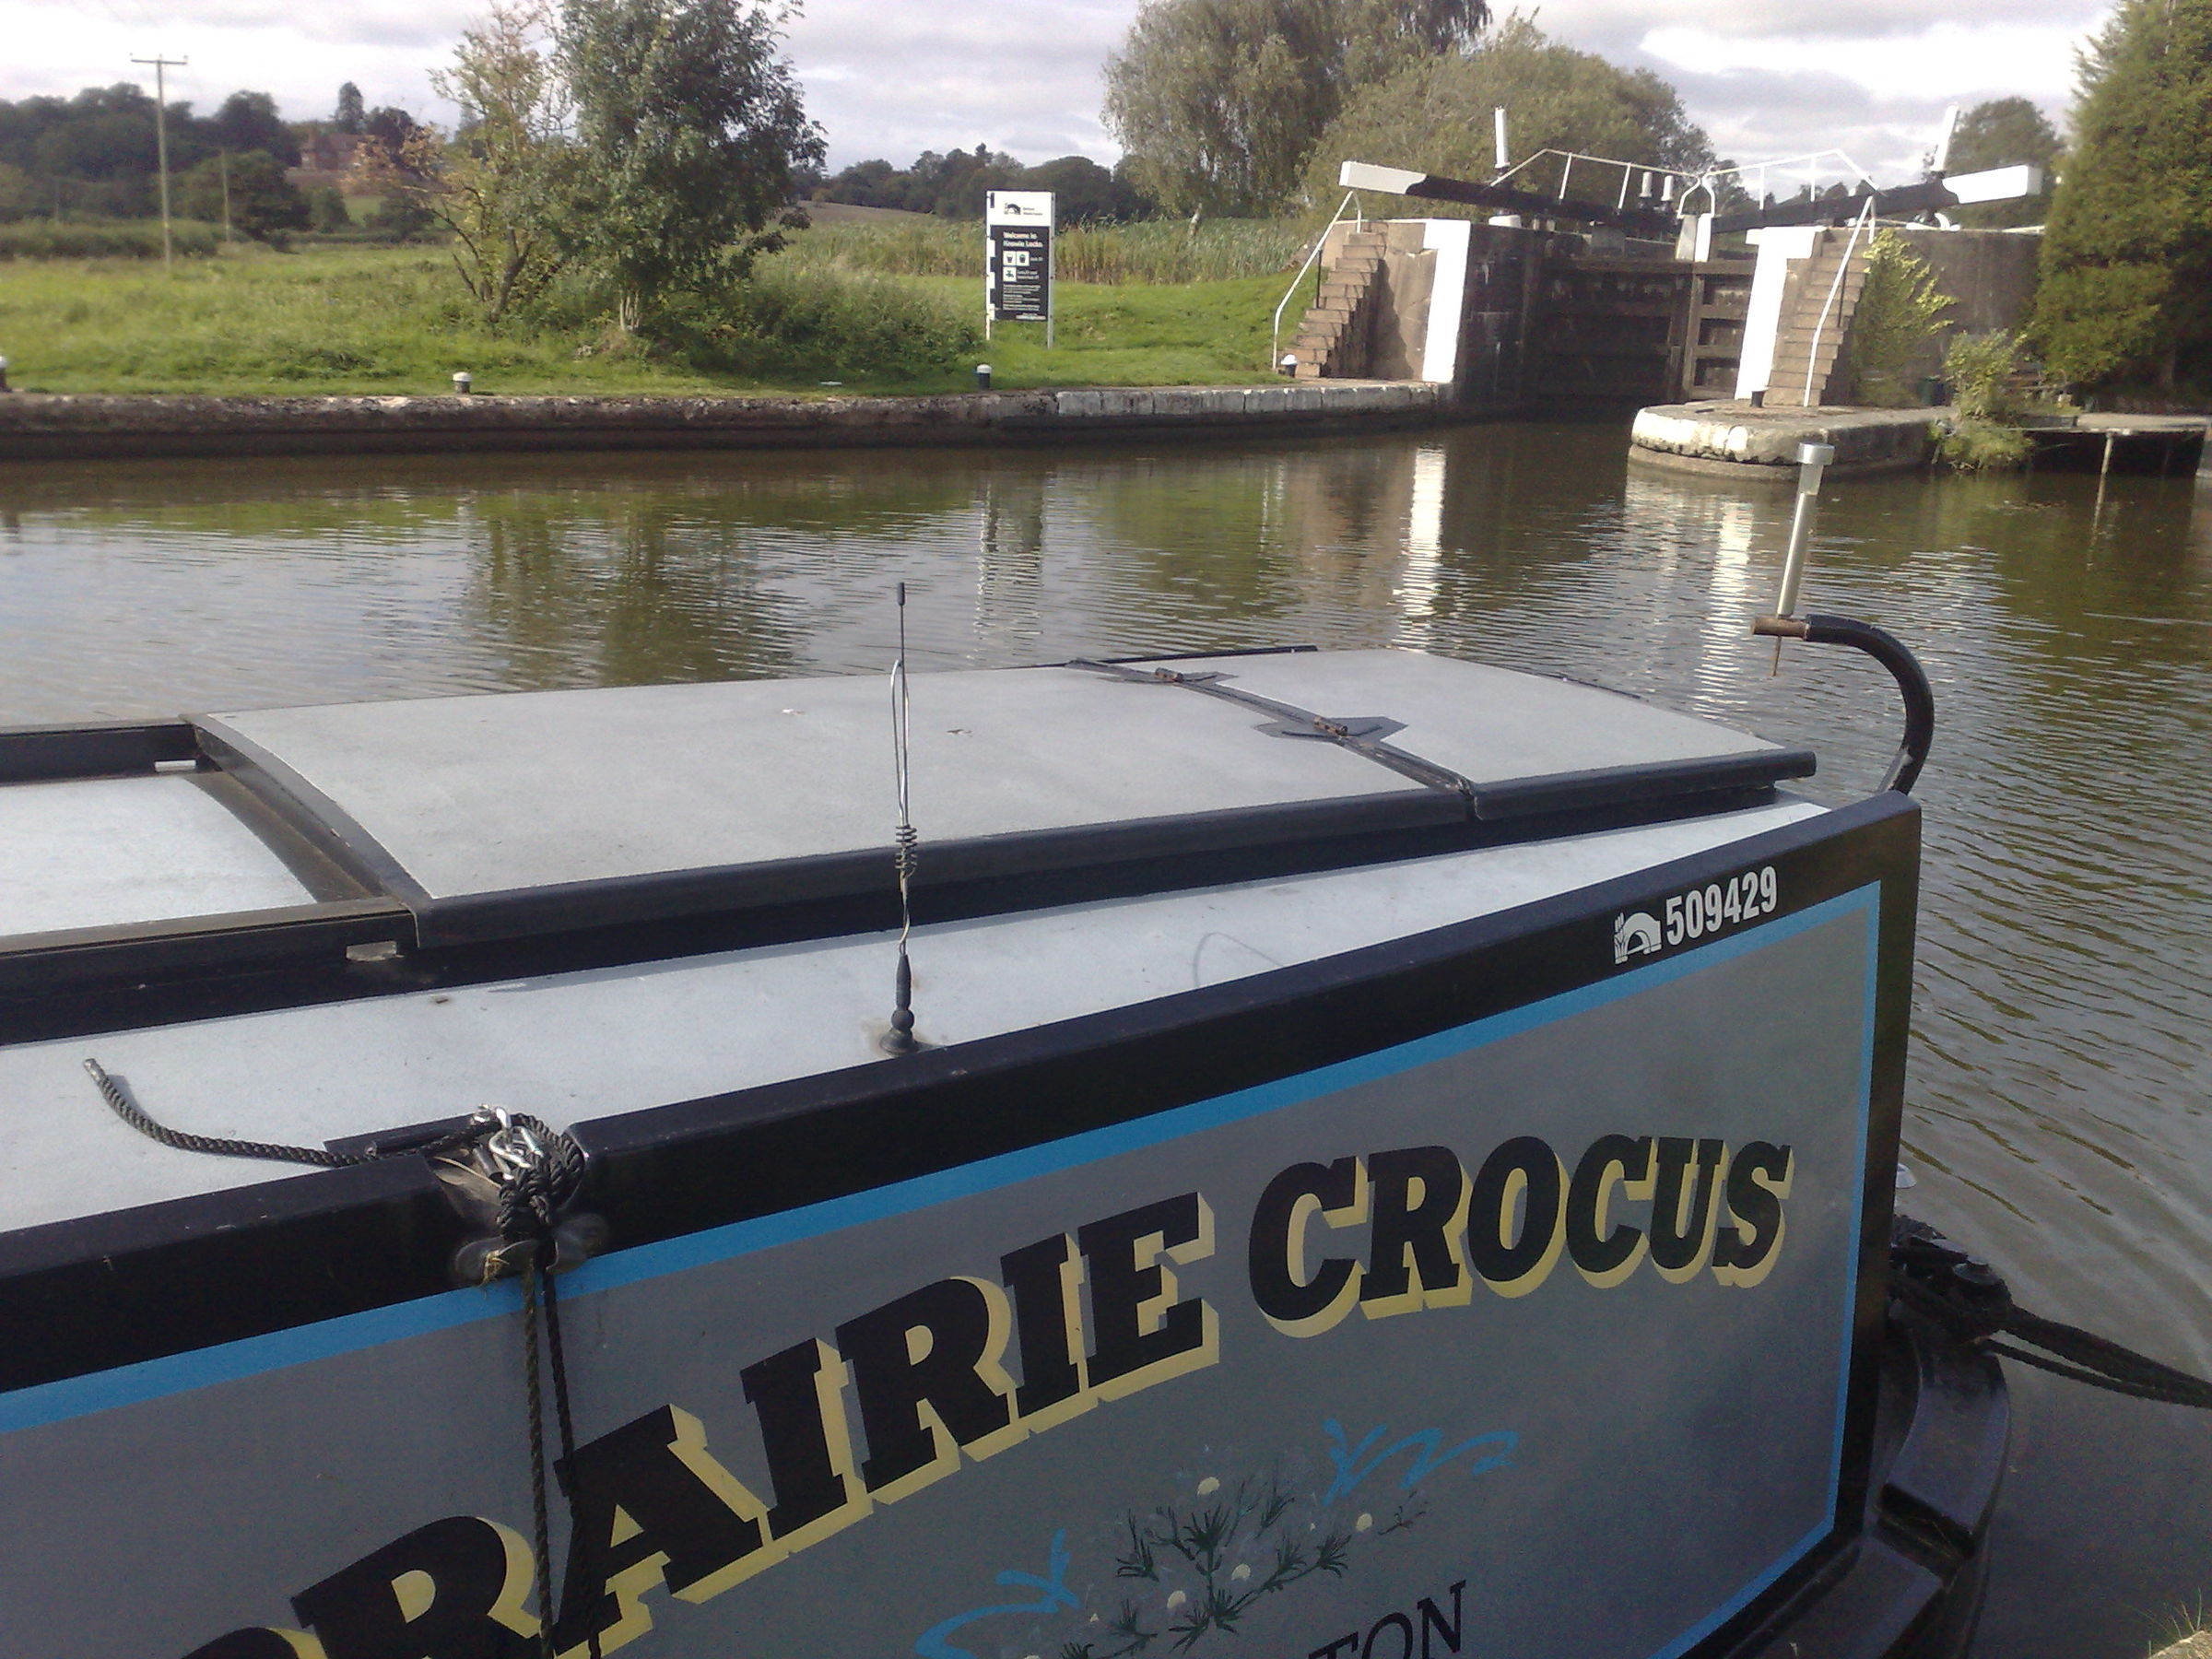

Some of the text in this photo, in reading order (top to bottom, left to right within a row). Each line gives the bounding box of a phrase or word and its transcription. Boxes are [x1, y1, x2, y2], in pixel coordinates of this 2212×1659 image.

[1665, 865, 1778, 946] 509429
[180, 1134, 1794, 1659] RAIRIE CROCUS
